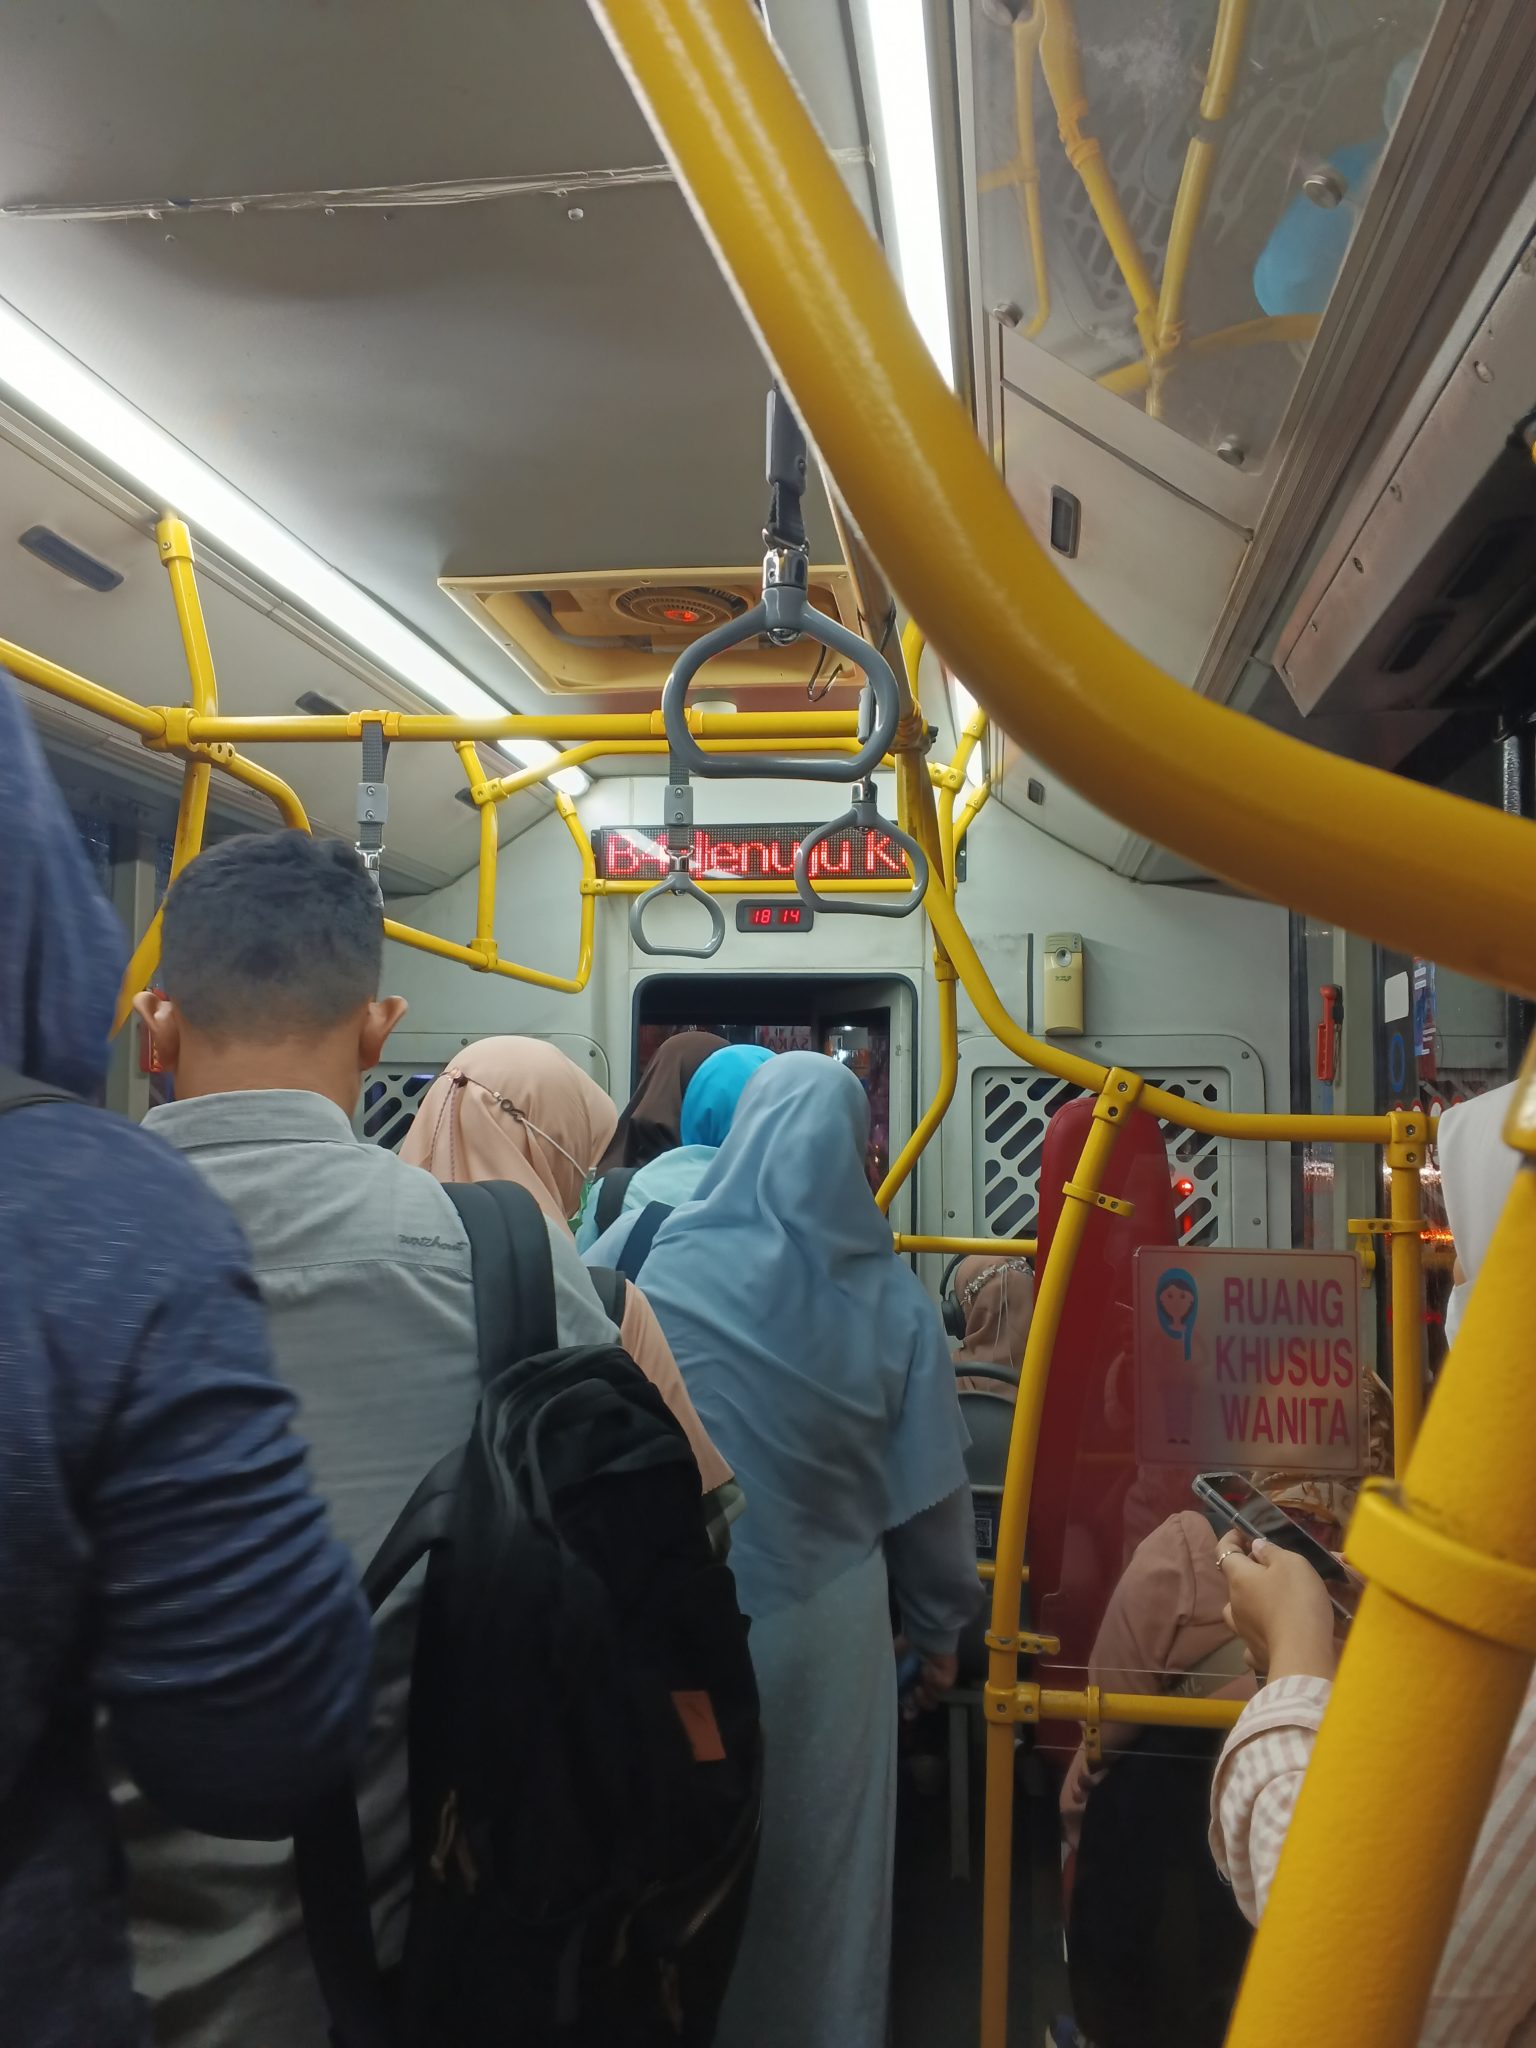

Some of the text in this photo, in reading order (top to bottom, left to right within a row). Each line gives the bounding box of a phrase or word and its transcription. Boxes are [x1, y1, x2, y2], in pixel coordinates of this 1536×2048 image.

[755, 909, 800, 924] 18 14
[1223, 1277, 1344, 1328] RUANG
[1216, 1335, 1353, 1388] KHUSUS
[1219, 1394, 1350, 1446] WANITA
